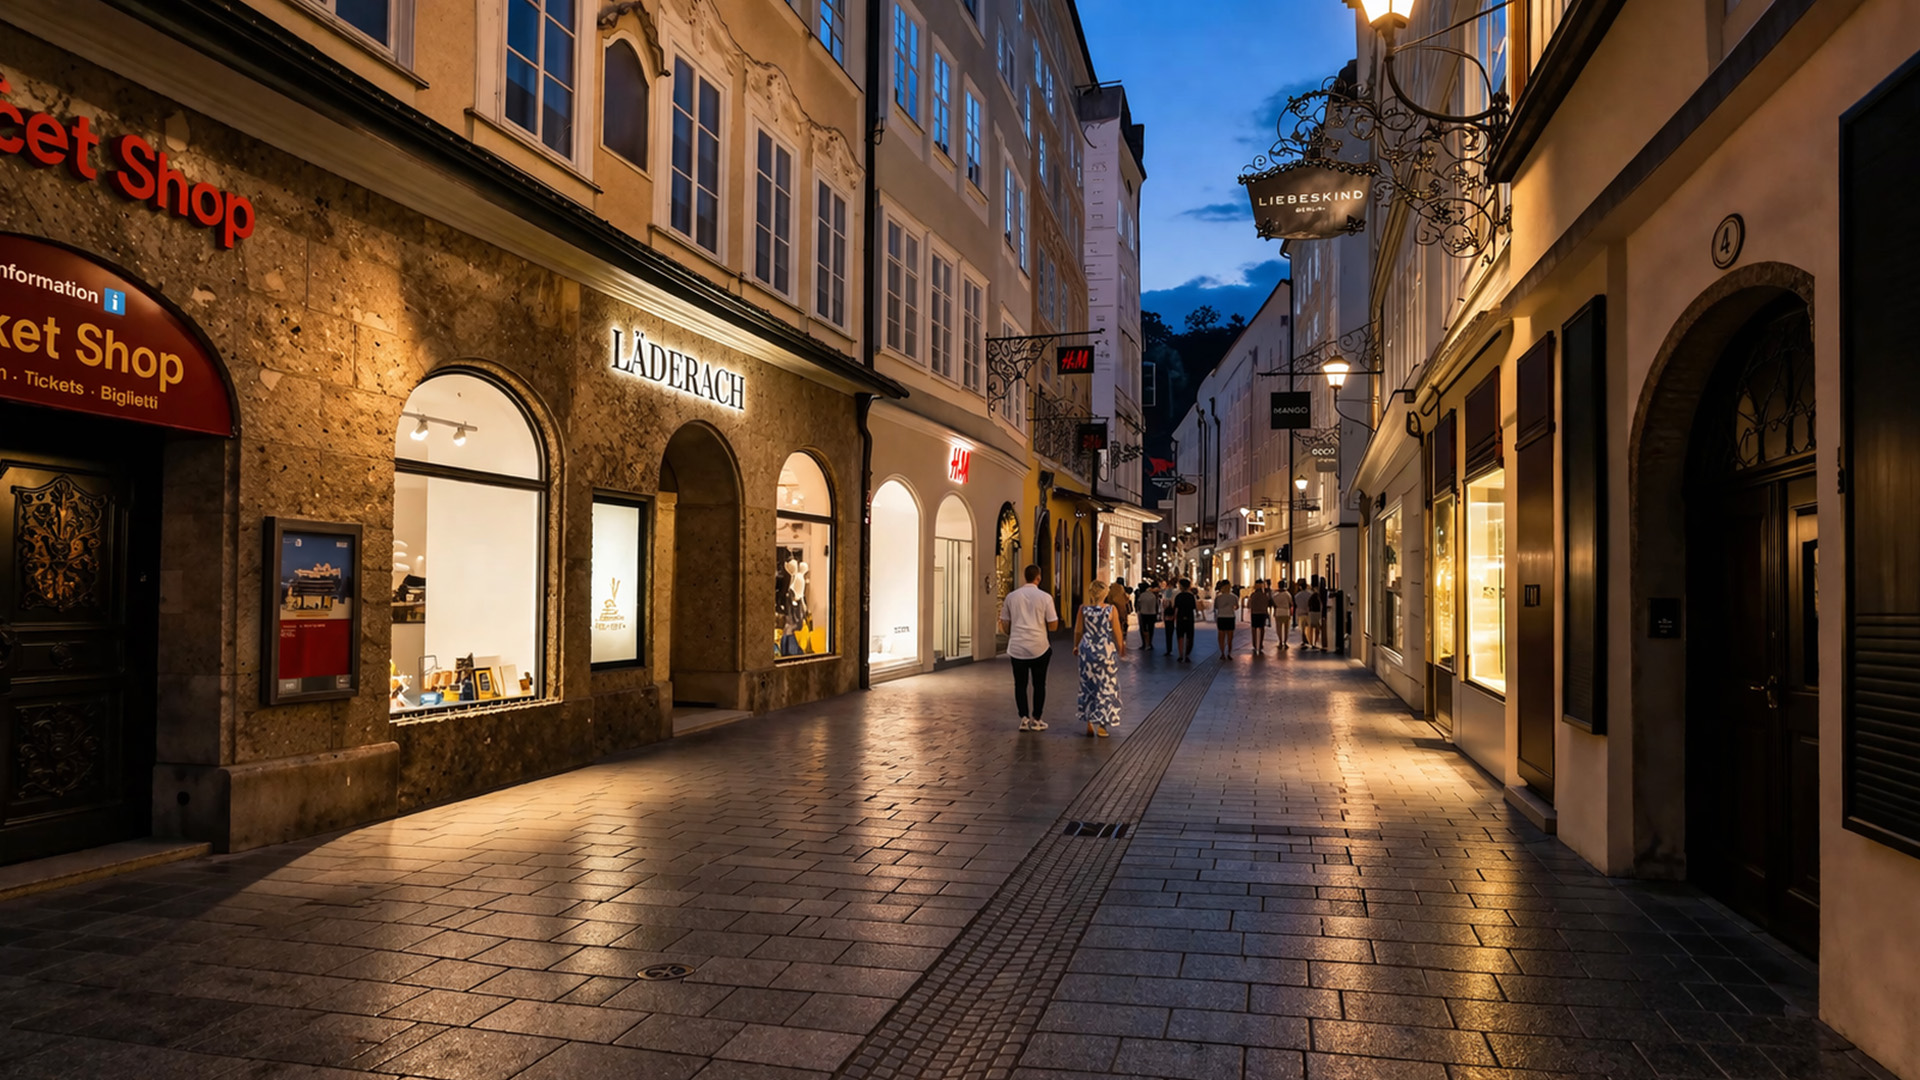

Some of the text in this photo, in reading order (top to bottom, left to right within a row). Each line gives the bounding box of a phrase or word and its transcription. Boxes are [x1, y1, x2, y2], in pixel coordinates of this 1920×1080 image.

[114, 134, 255, 249] Shop
[1258, 190, 1364, 206] LIEBESKIND
[1720, 226, 1730, 254] 4
[75, 322, 184, 393] Shop
[612, 329, 745, 410] LÄDERACH
[24, 369, 84, 395] Tickets
[101, 385, 158, 410] Biglietti
